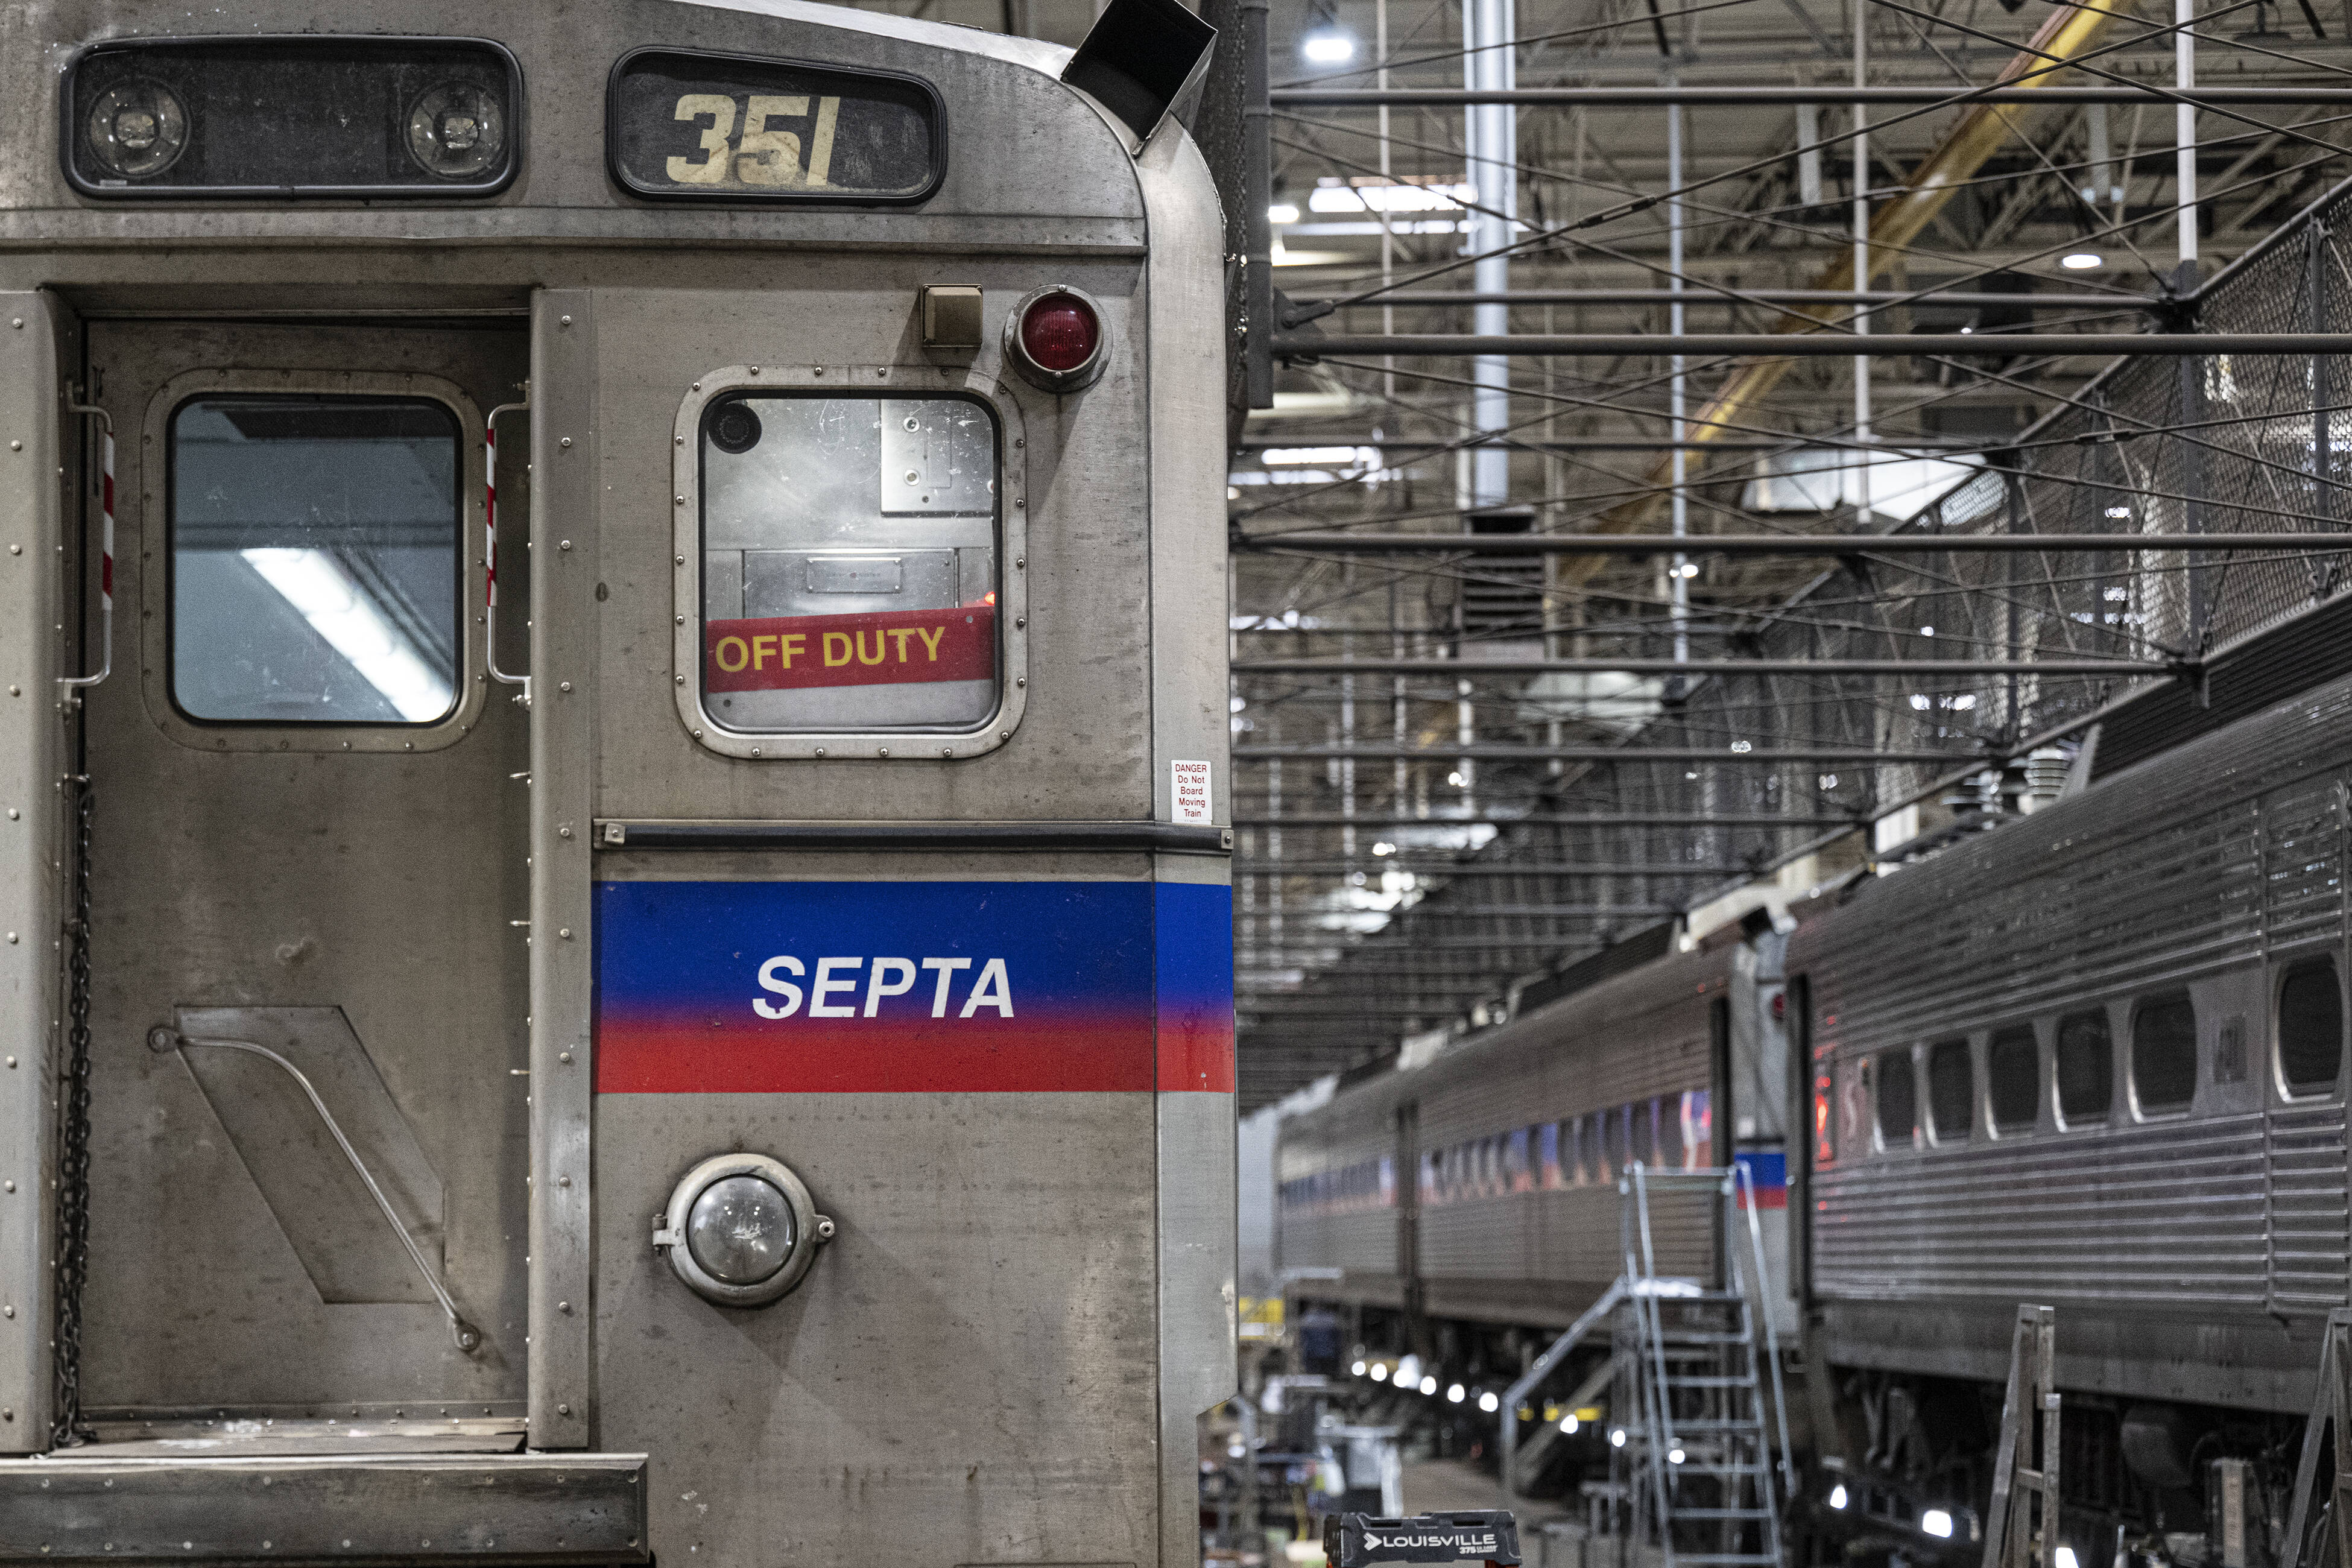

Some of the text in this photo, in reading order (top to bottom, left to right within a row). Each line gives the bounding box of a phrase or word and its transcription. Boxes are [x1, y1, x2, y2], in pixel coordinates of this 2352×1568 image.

[666, 94, 840, 185] 351
[716, 627, 945, 672] OFF DUTY
[1175, 764, 1207, 773] DANGER
[1180, 786, 1203, 795] Board
[1179, 798, 1206, 808] Moving
[1184, 809, 1201, 817] Train
[753, 955, 1014, 1019] SEPTA
[1383, 1534, 1496, 1547] LOUISVILLE
